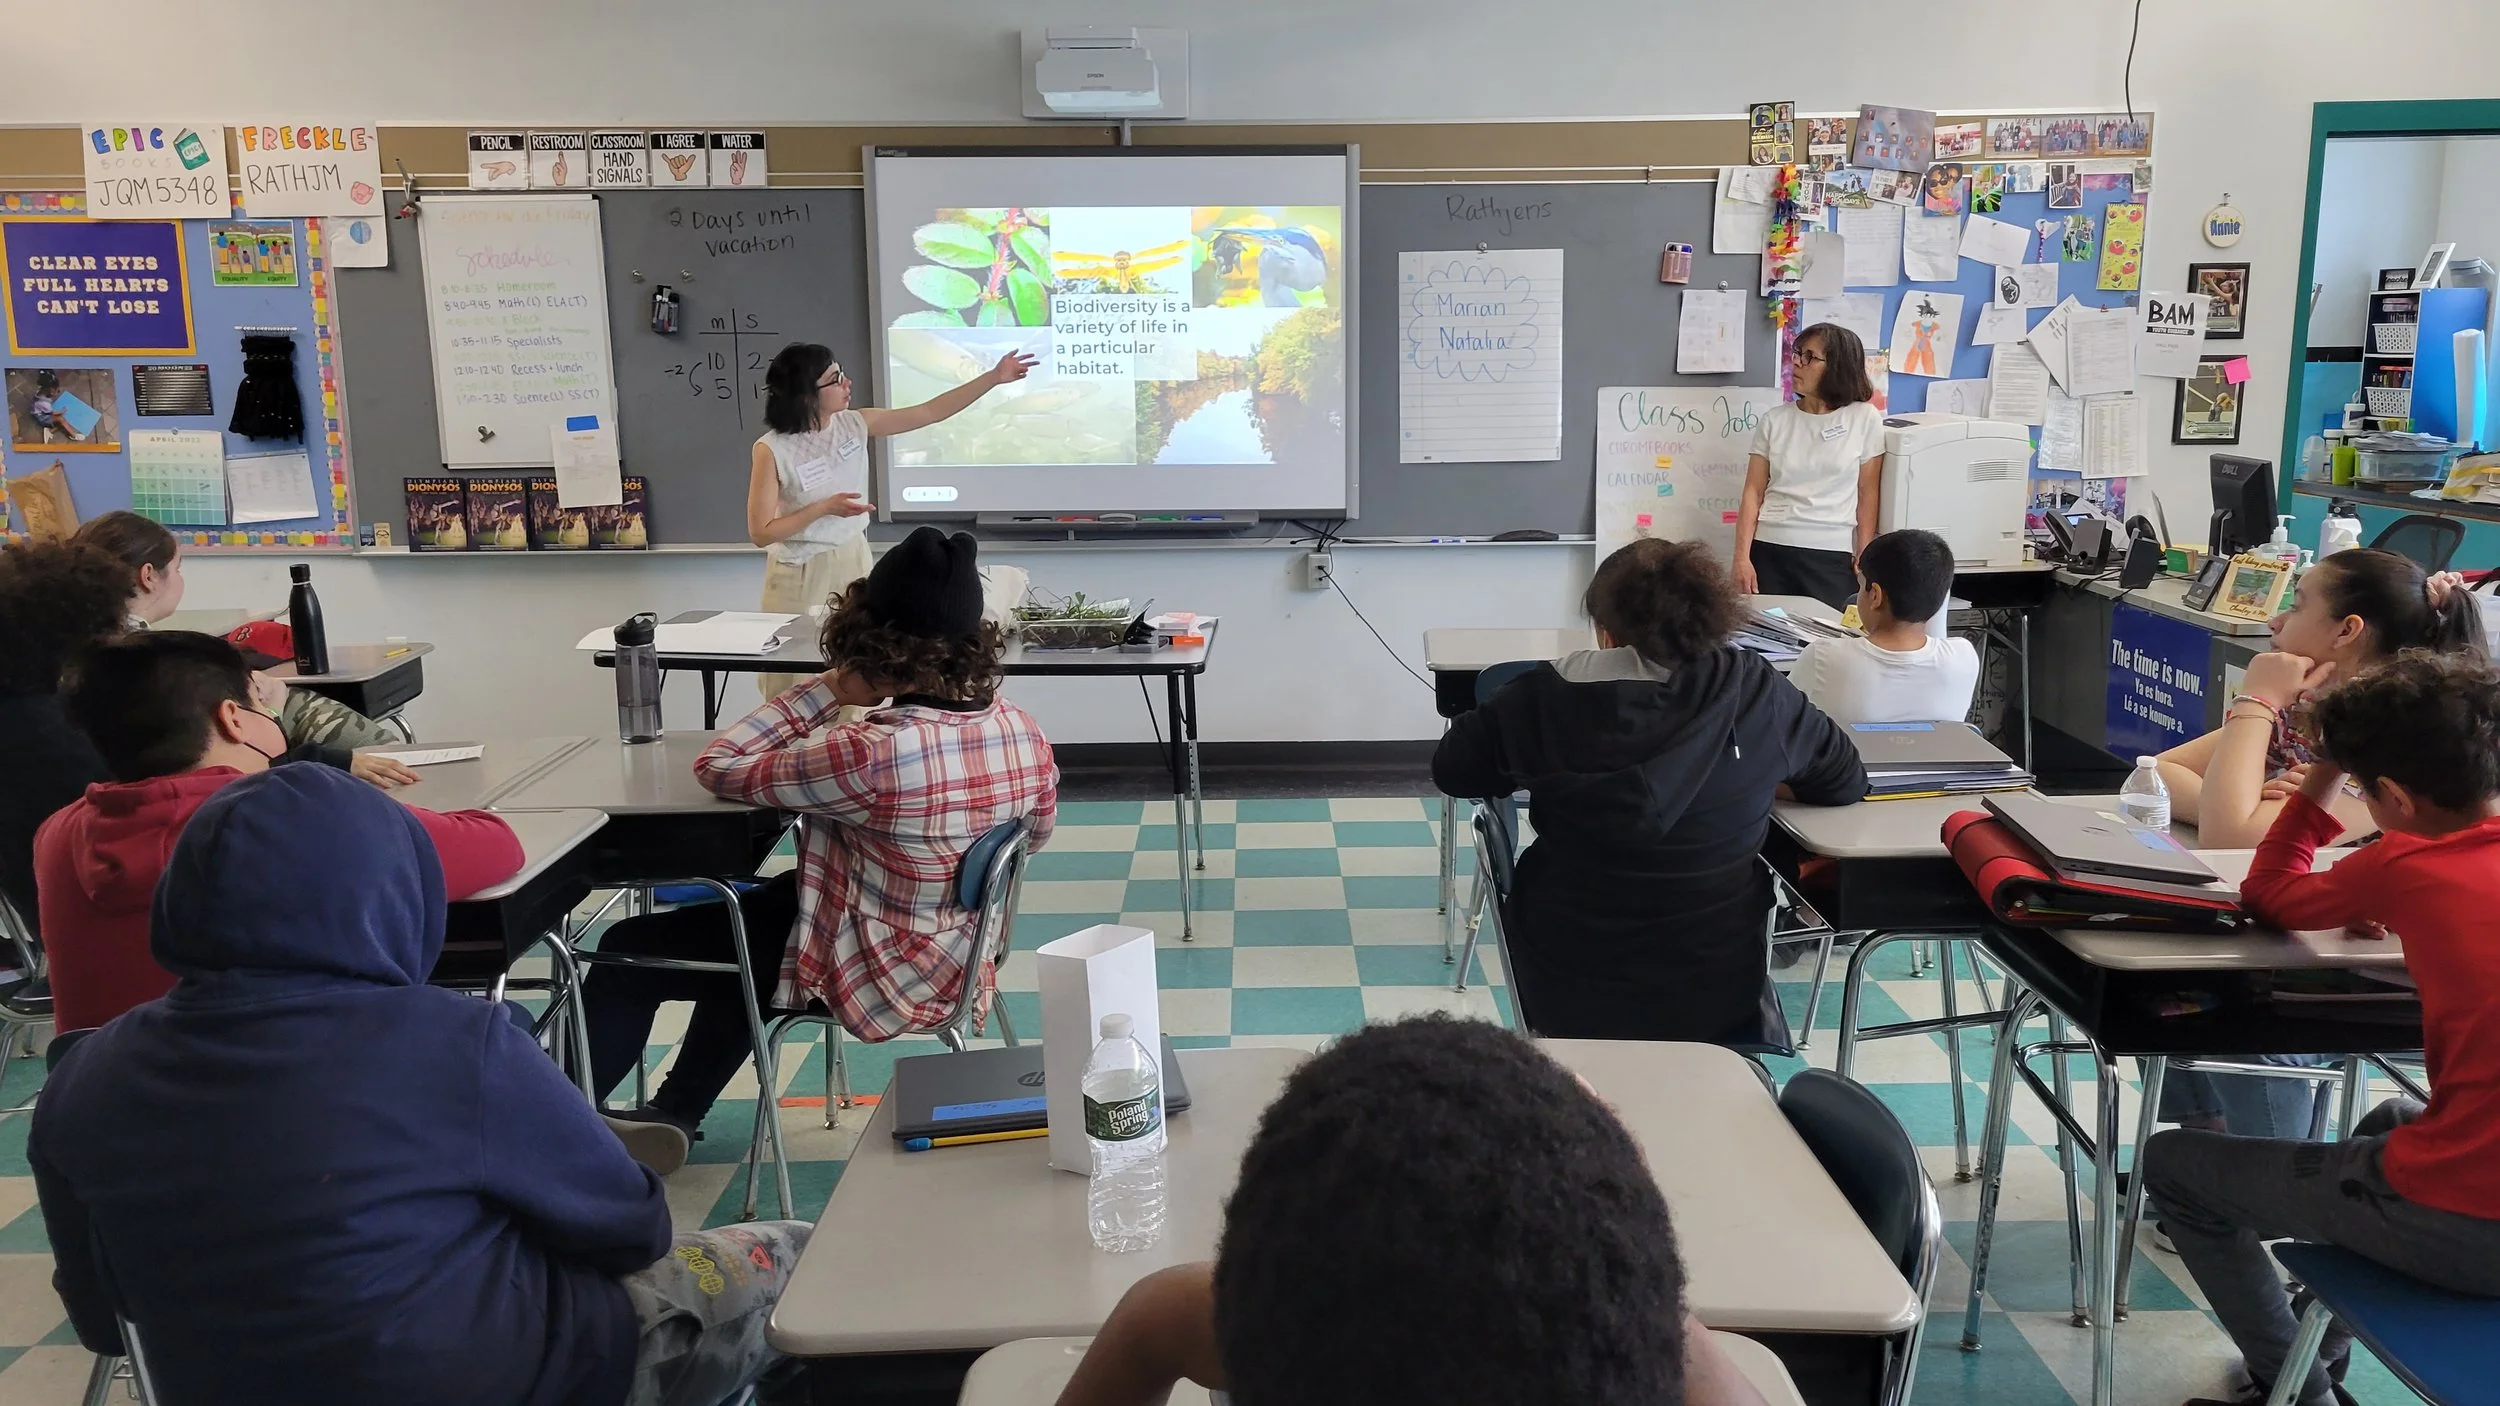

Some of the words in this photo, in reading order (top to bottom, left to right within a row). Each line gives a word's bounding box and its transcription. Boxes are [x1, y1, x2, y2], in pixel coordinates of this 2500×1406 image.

[92, 128, 164, 154] EPIC
[242, 126, 368, 152] FRECKLE
[480, 136, 514, 150] PENCIL
[532, 135, 584, 150] RESTROOM
[592, 136, 645, 149] CLASSROOM
[660, 134, 664, 148] I
[666, 134, 696, 148] AGREE
[722, 134, 752, 148] WATER
[604, 152, 634, 167] HAND
[246, 164, 342, 194] RATHJM
[597, 168, 643, 184] SIGNALS
[94, 175, 218, 206] JQM5348
[758, 203, 812, 227] until
[1446, 194, 1552, 237] Rathjens
[2210, 218, 2240, 236] Annie
[29, 256, 97, 270] CLEAR
[104, 256, 158, 270] EYES
[23, 278, 76, 292] FULL
[84, 278, 169, 292] HEARTS
[37, 300, 99, 314] CAN'T
[107, 300, 160, 314] LOSE
[1056, 298, 1158, 316] Biodiversity
[1163, 298, 1176, 312] is
[1181, 302, 1190, 312] a
[1437, 292, 1506, 317] Marian
[2148, 300, 2194, 326] BAM
[1055, 320, 1114, 336] variety
[1120, 320, 1136, 333] of
[1142, 320, 1168, 333] life
[1172, 320, 1188, 333] in
[507, 334, 563, 350] Specialists
[1440, 326, 1510, 350] Natalia
[1056, 344, 1066, 354] a
[1072, 340, 1156, 357] particular
[511, 364, 547, 376] Recess
[556, 362, 584, 374] lunch
[708, 352, 725, 370] 10
[1058, 360, 1124, 374] habitat.
[715, 378, 732, 400] 5
[1618, 390, 1704, 434] Class
[1713, 396, 1759, 438] Job
[1608, 440, 1694, 456] CHROMEBOOKS
[532, 482, 557, 491] DION
[624, 482, 642, 490] SOS
[1608, 470, 1670, 487] CALENDAR
[408, 484, 460, 492] DIONYSOS
[470, 484, 523, 492] DIONYSOS
[2112, 638, 2131, 668] The
[2133, 648, 2160, 680] time
[2162, 658, 2173, 685] is
[2175, 668, 2203, 696] now.
[2135, 678, 2144, 696] Ya
[2145, 686, 2154, 700] es
[2154, 685, 2174, 708] hora.
[2124, 694, 2132, 712] Lé
[2134, 702, 2138, 714] a
[2140, 704, 2148, 718] se
[2149, 704, 2176, 730] kounye
[2176, 720, 2184, 734] a.
[1108, 1098, 1147, 1123] Poland
[1110, 1110, 1149, 1135] Spring
